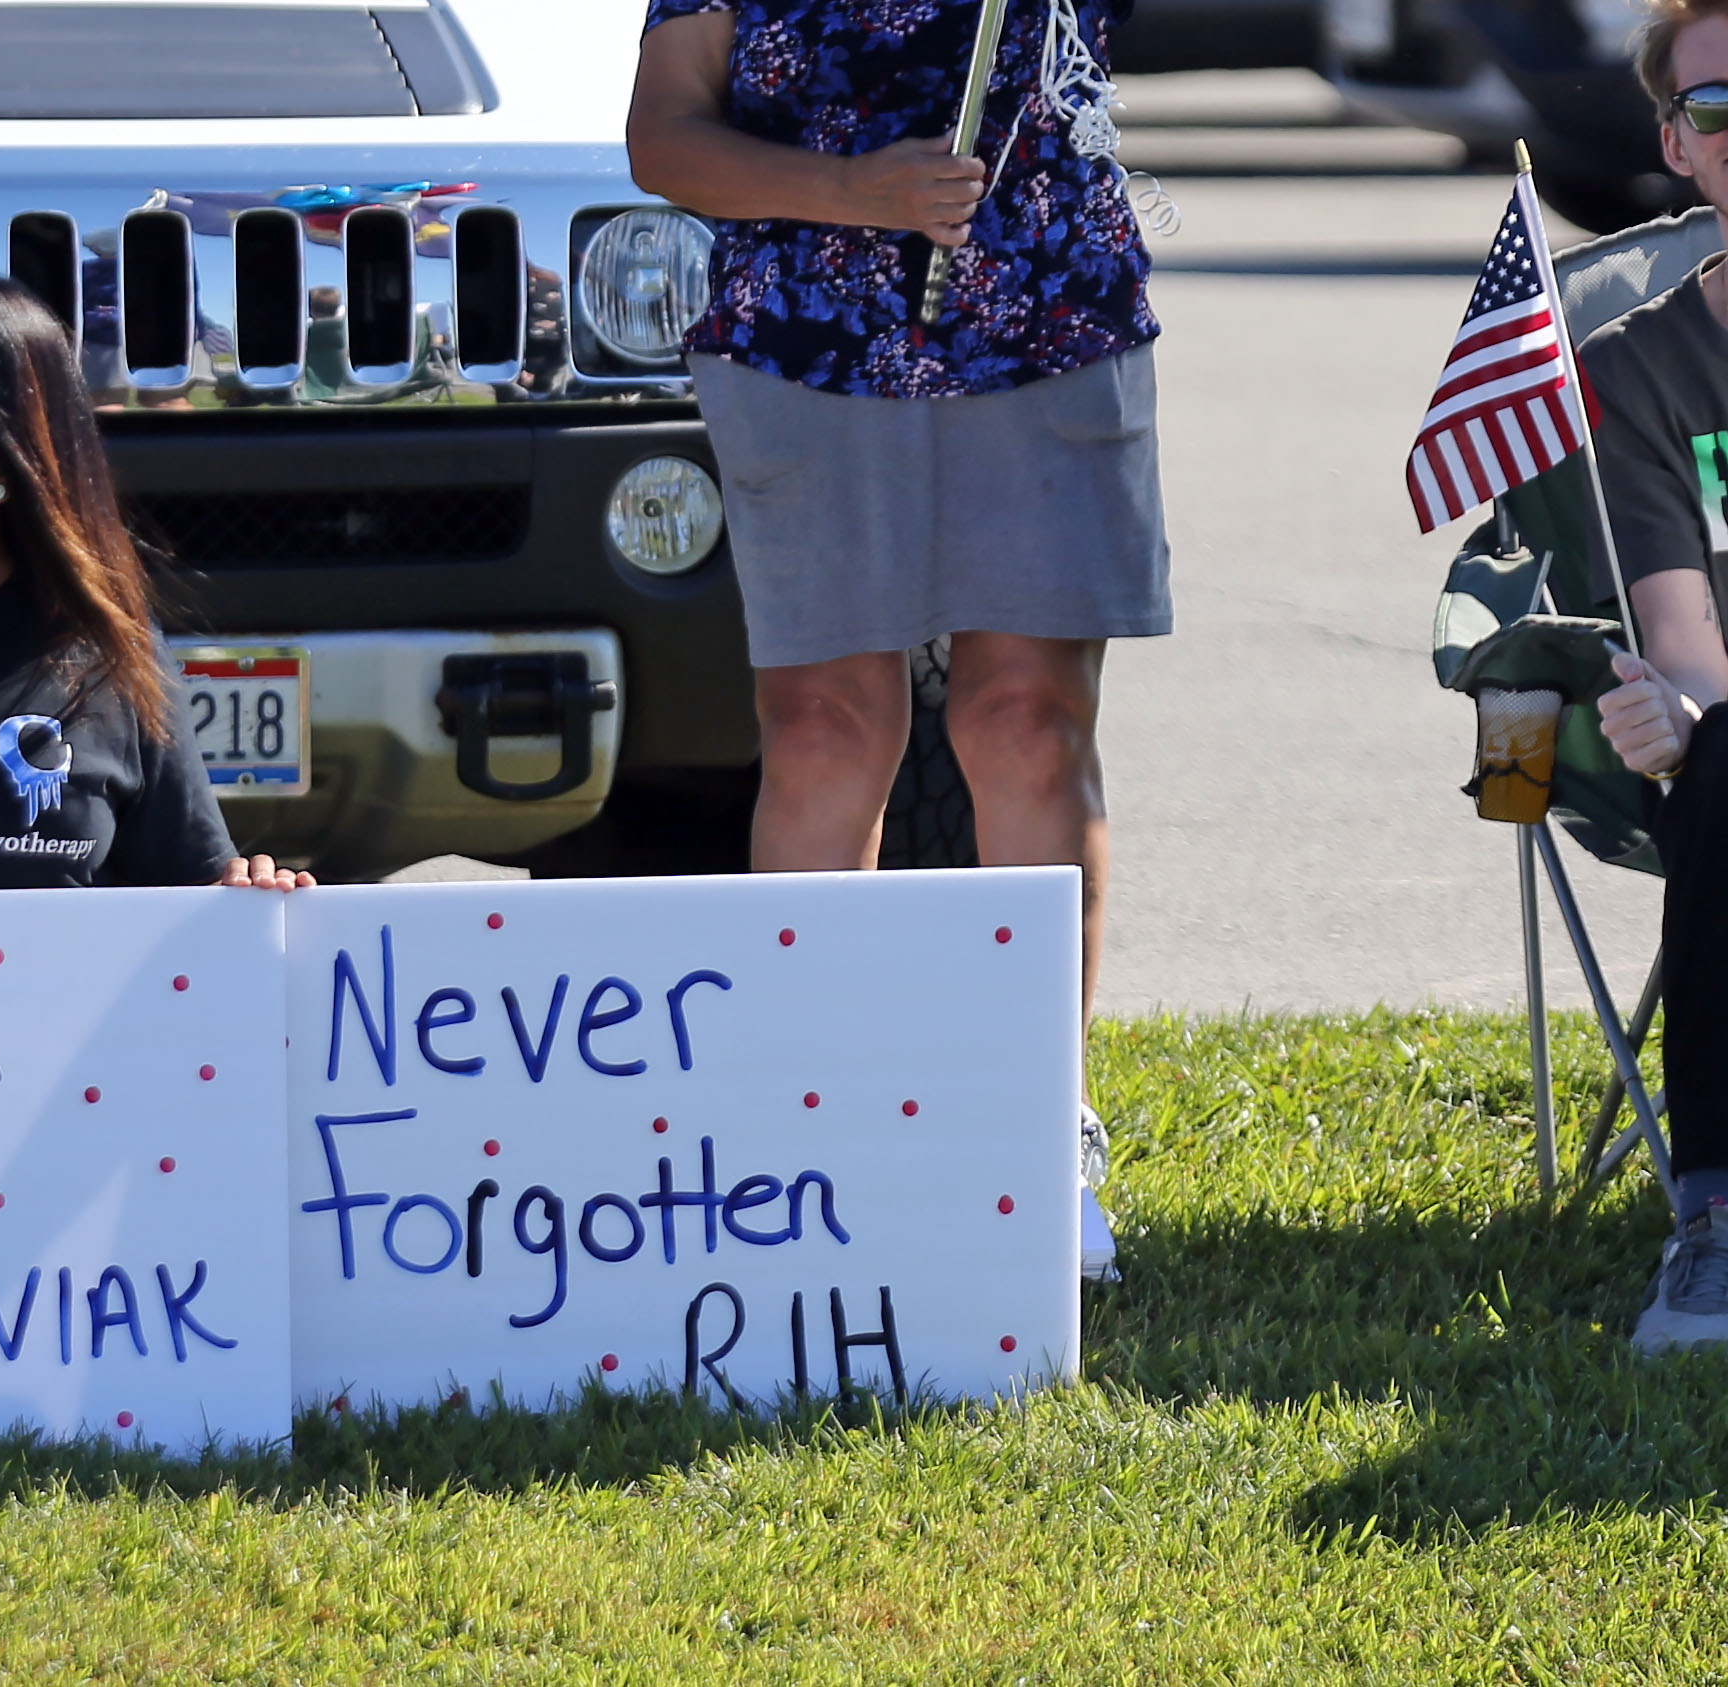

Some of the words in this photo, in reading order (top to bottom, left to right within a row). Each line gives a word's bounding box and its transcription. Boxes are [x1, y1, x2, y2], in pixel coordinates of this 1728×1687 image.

[326, 923, 734, 1086] Never
[300, 1107, 851, 1329] Forgotten
[683, 1281, 907, 1412] RIH
